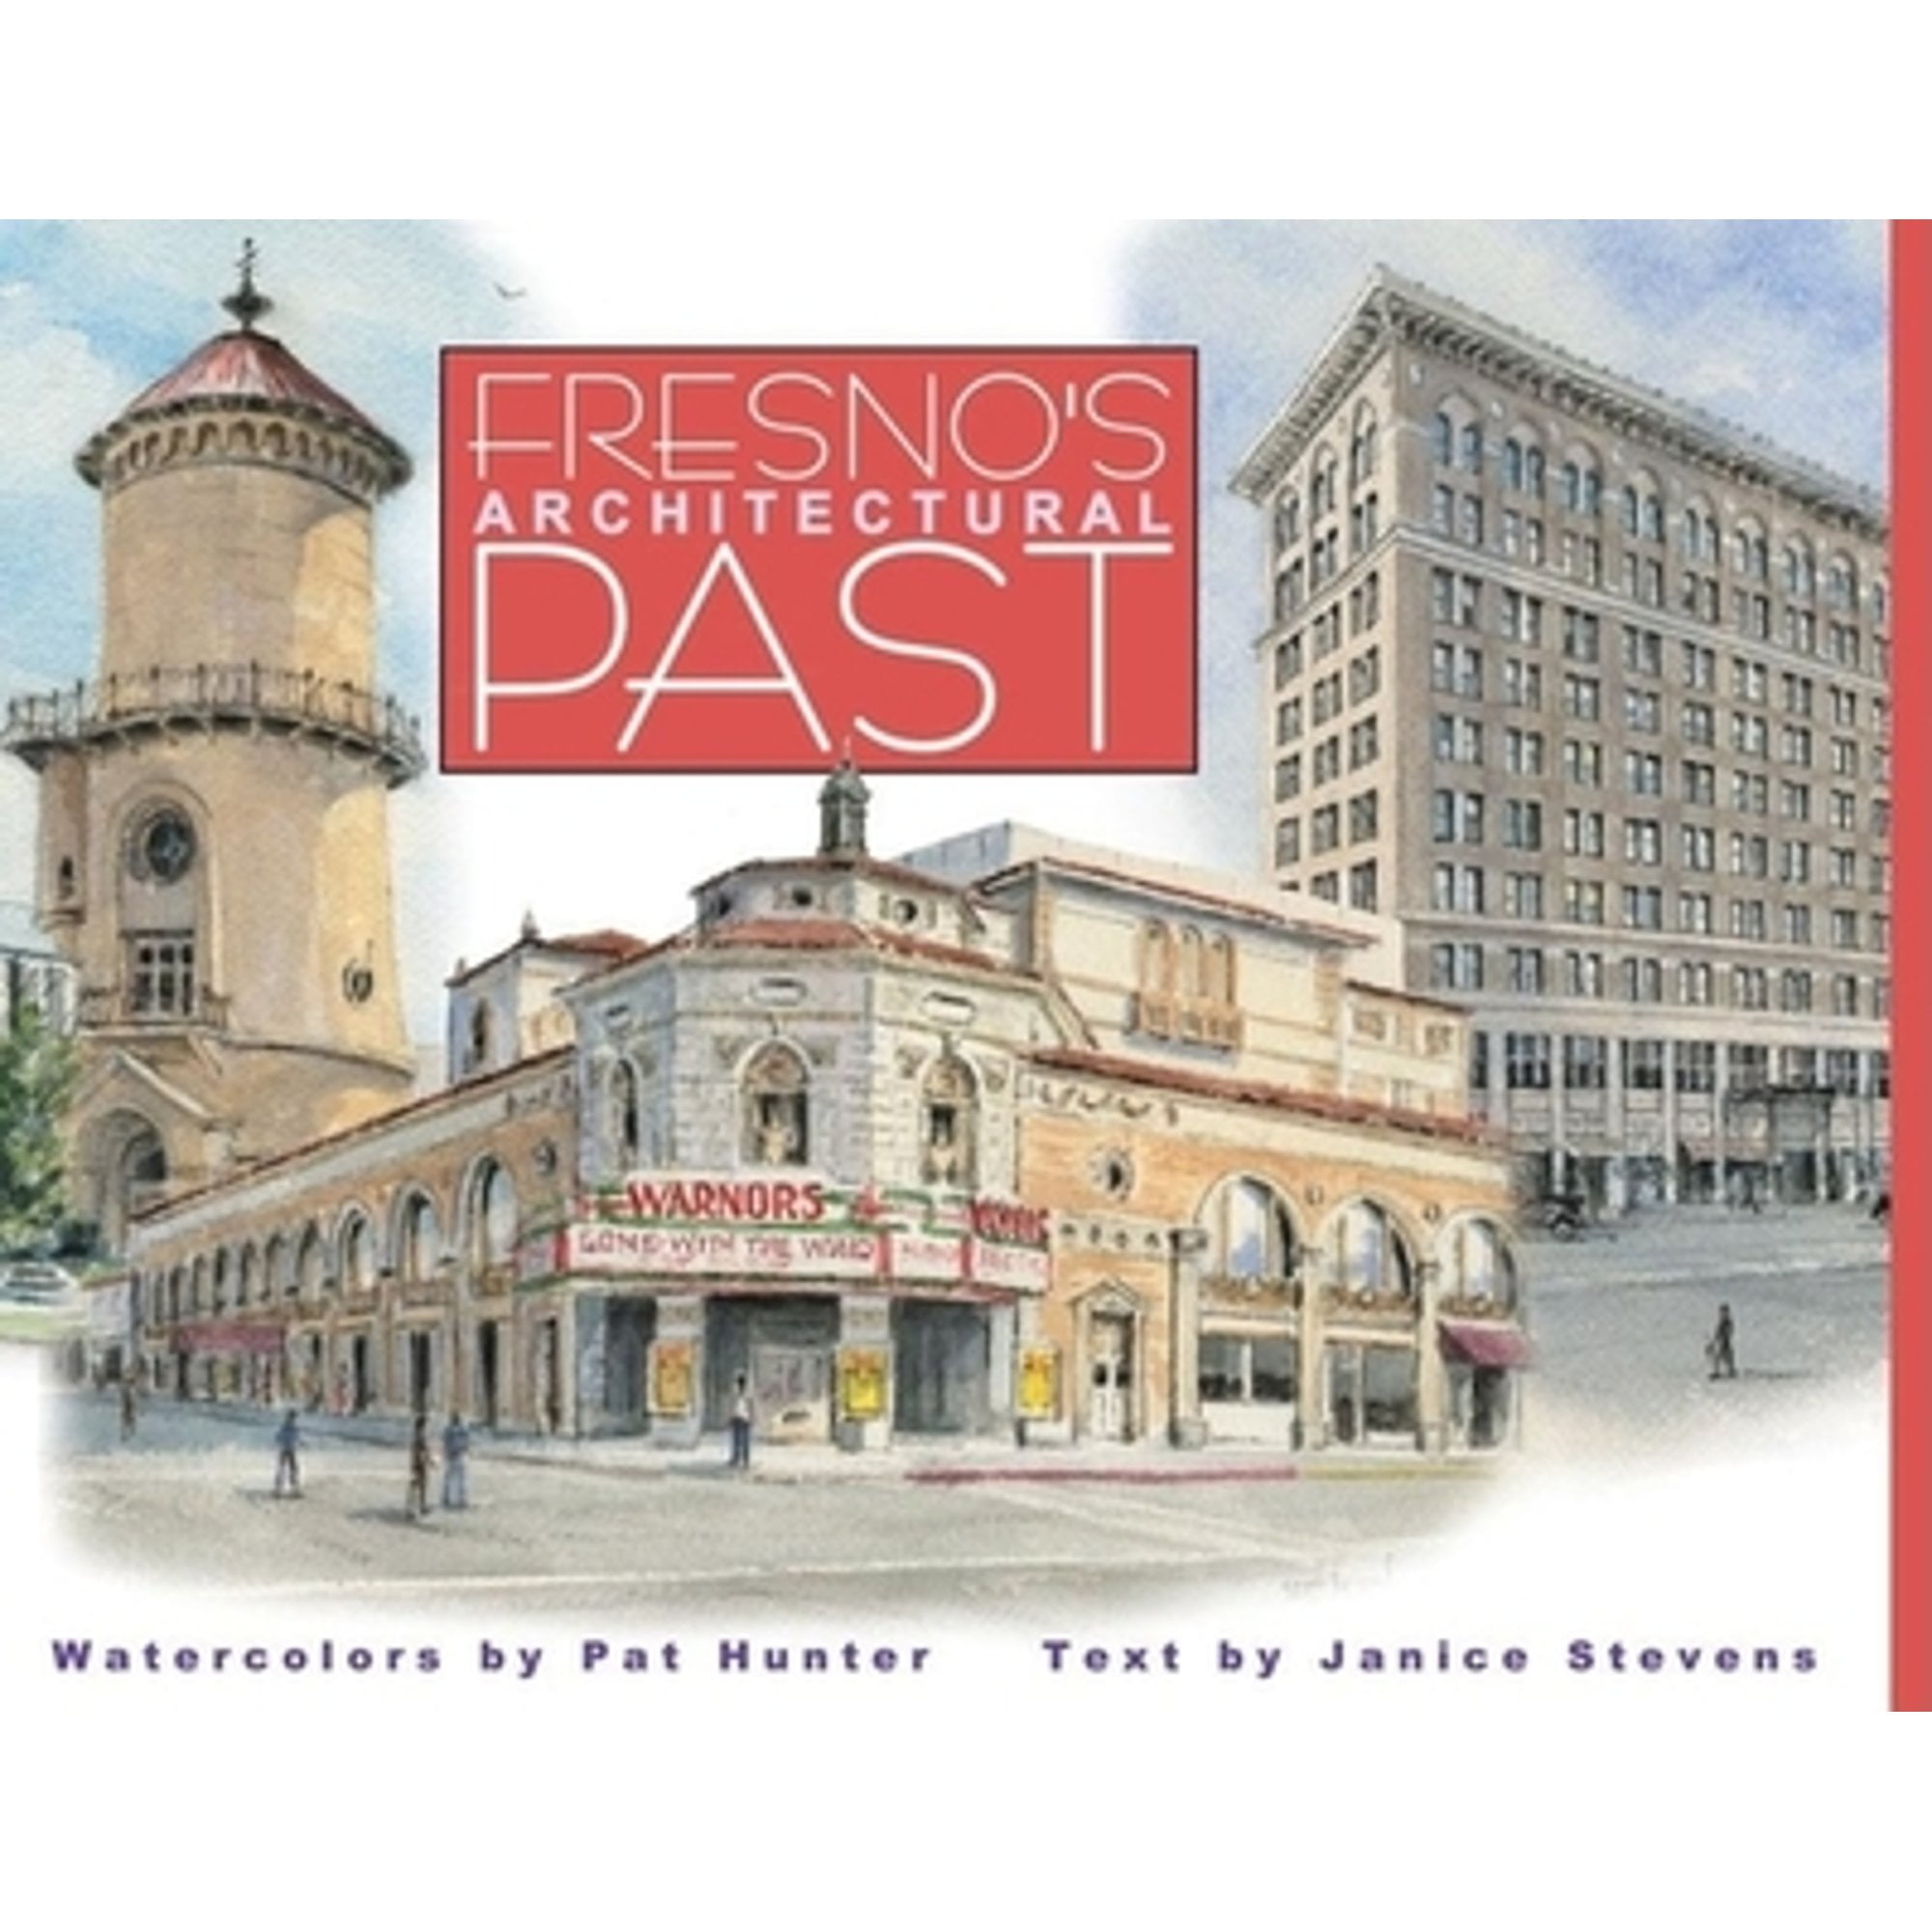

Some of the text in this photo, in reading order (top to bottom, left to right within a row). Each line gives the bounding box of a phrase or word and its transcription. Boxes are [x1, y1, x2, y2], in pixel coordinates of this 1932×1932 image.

[469, 373, 1170, 481] FRESNO'S
[474, 490, 1172, 535] ARCHITECTURAL
[474, 542, 1174, 753] PAST
[627, 1179, 825, 1221] WARNORS
[51, 1639, 930, 1680] Watercolors by Pat Hunter
[1041, 1639, 1816, 1680] Text by Janice Stevens
